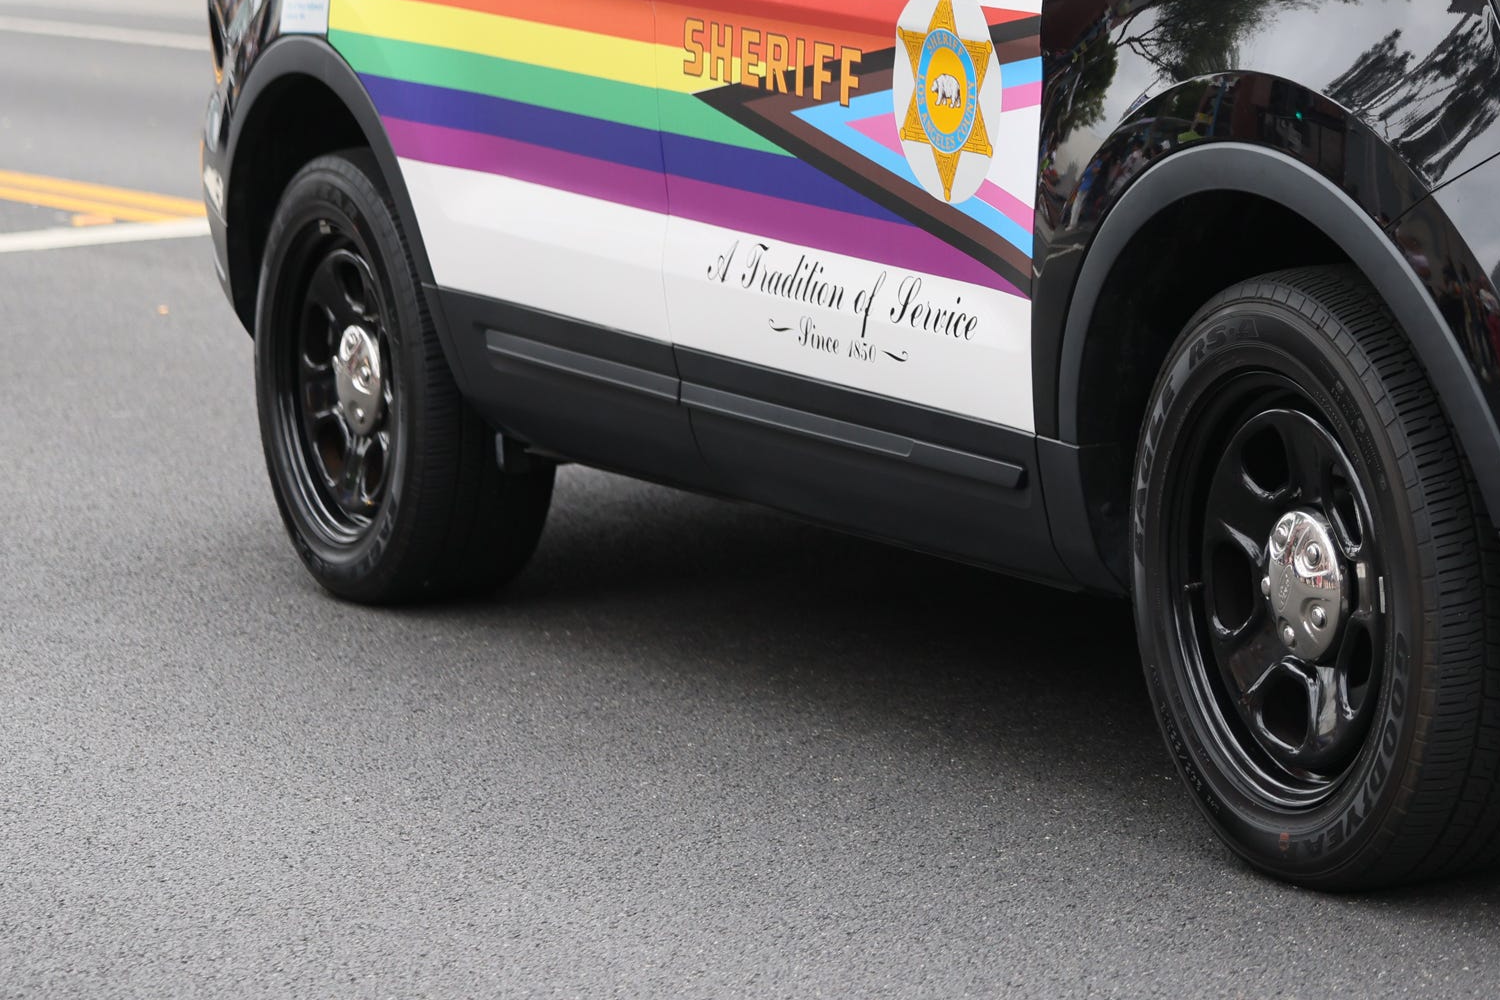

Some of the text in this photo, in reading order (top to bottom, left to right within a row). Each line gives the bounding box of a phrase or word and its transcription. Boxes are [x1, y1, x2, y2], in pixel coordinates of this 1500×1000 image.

[683, 17, 863, 108] SHERIFF
[926, 32, 964, 57] SHERIFF
[916, 73, 976, 151] LOS ANGELES COUNTY
[707, 240, 978, 341] A Tradition of Service
[798, 315, 877, 364] Since 1850
